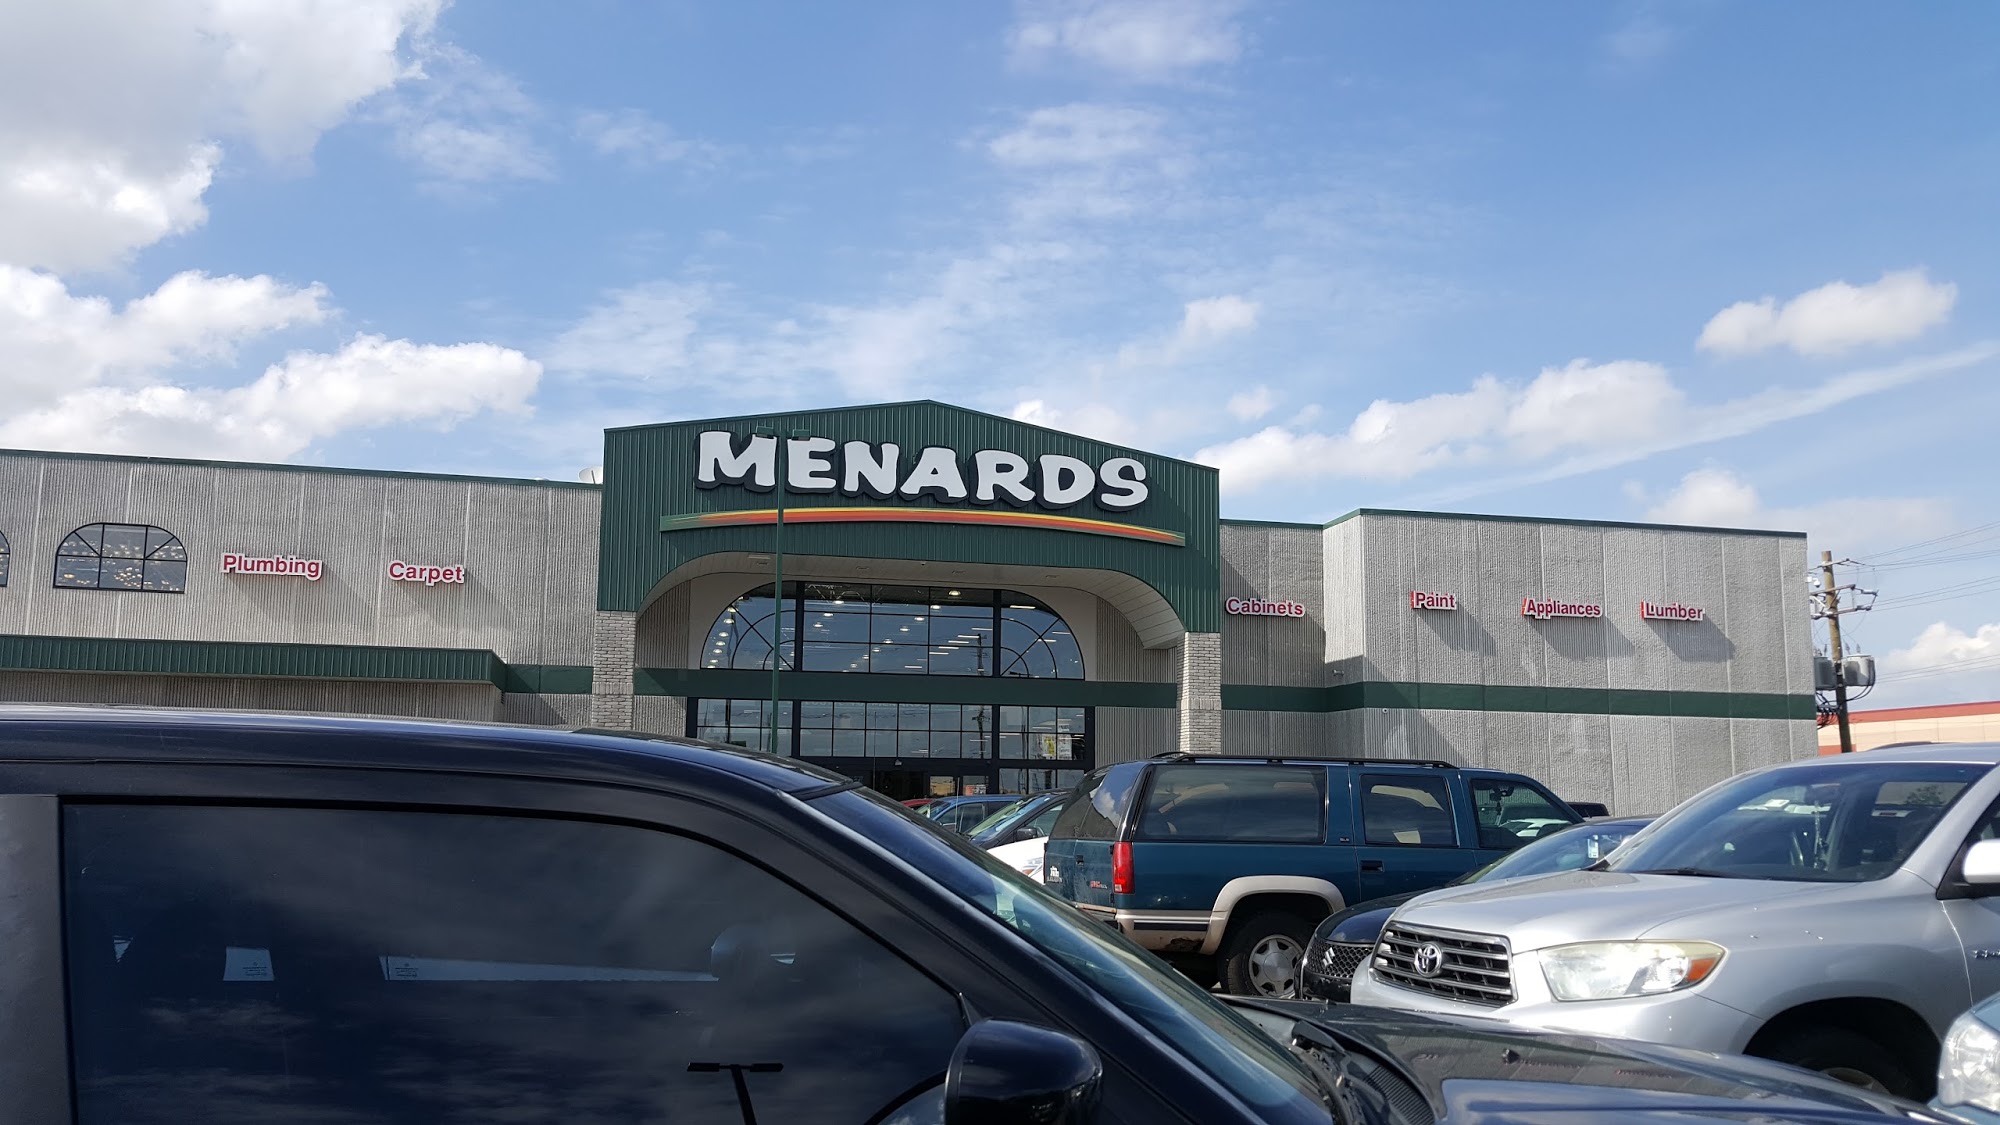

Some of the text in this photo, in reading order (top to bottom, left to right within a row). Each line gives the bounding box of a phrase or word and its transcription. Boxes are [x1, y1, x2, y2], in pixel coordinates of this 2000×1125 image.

[697, 430, 1149, 507] MENARDS
[222, 554, 321, 579] Plumbing
[388, 562, 463, 585] Carpet
[1226, 598, 1304, 616] Cabinets
[1414, 592, 1456, 608] Paint
[1526, 598, 1601, 618] Appliances
[1644, 602, 1705, 620] Lumber
